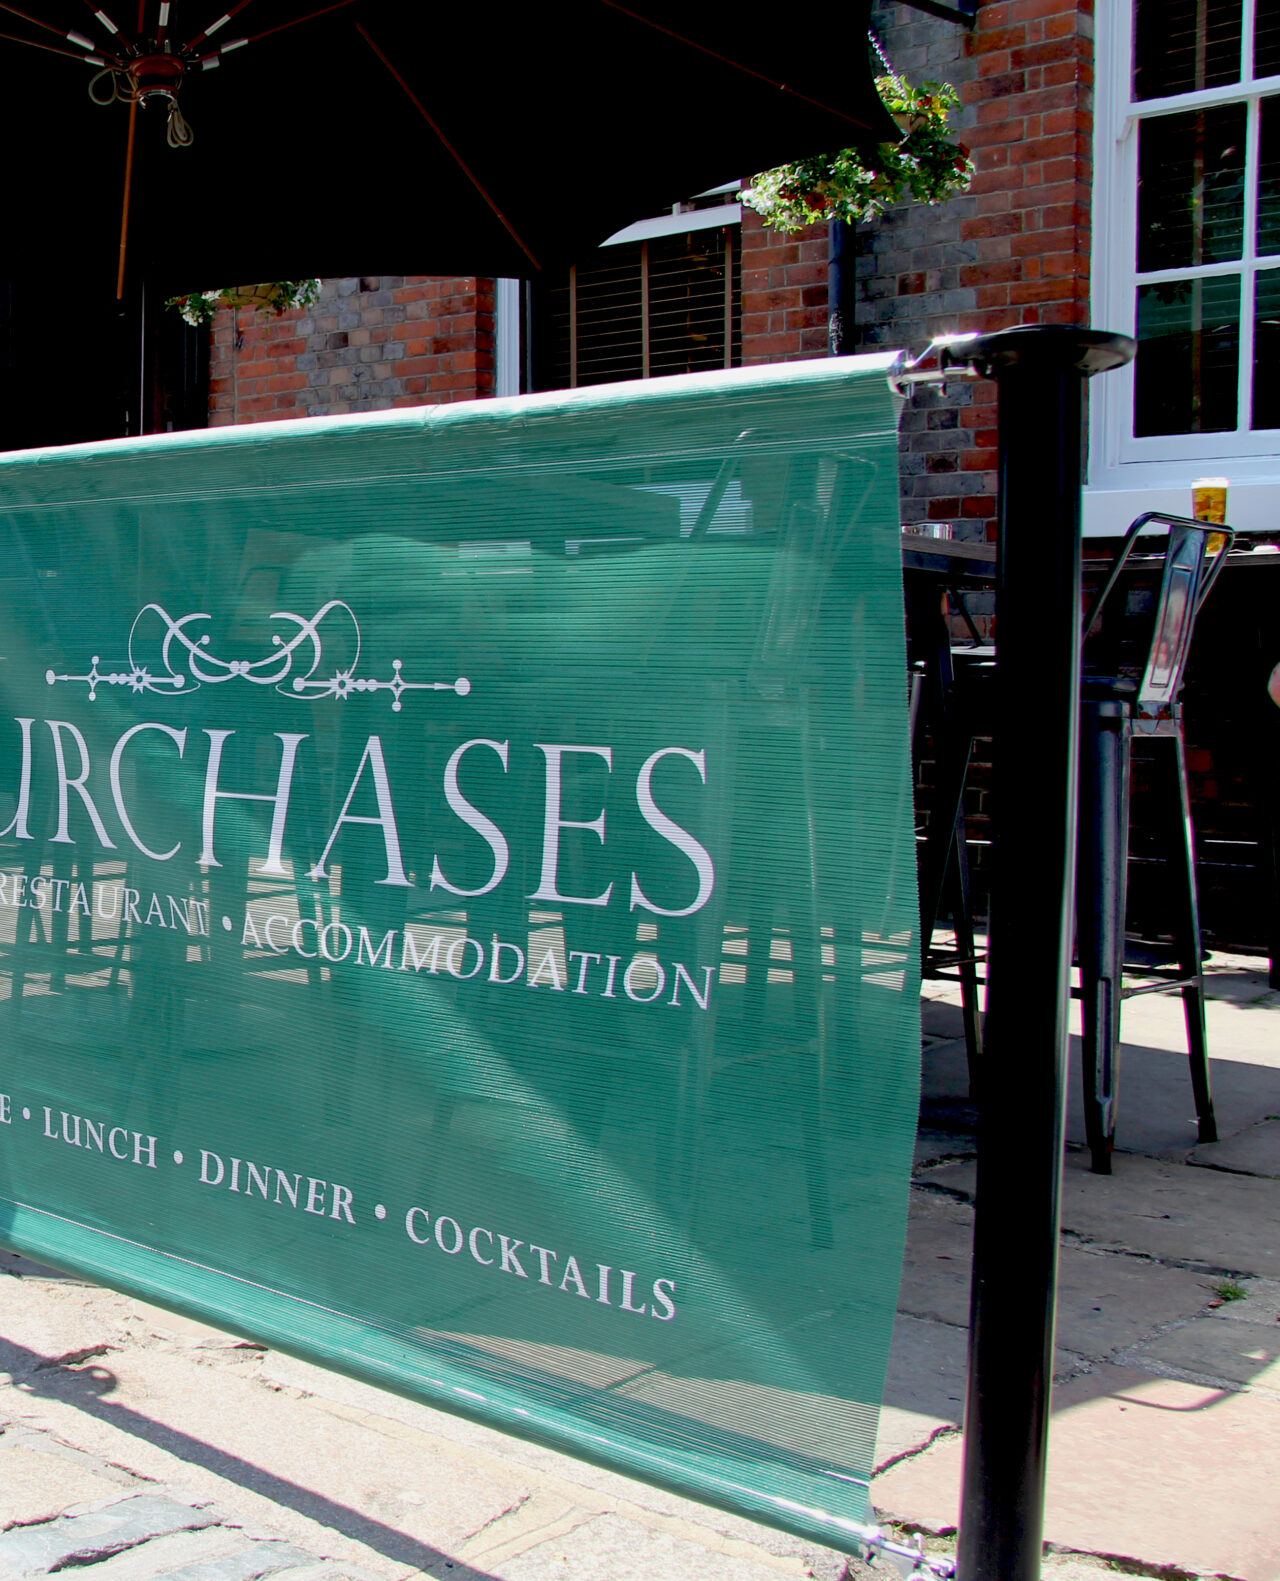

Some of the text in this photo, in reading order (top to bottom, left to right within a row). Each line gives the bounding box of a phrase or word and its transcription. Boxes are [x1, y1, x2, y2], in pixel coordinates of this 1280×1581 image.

[240, 911, 716, 1010] ACCOMMODATION
[43, 1106, 158, 1169] LUNCH
[198, 1149, 357, 1225] DINNER
[405, 1206, 676, 1321] COCKTAILS
